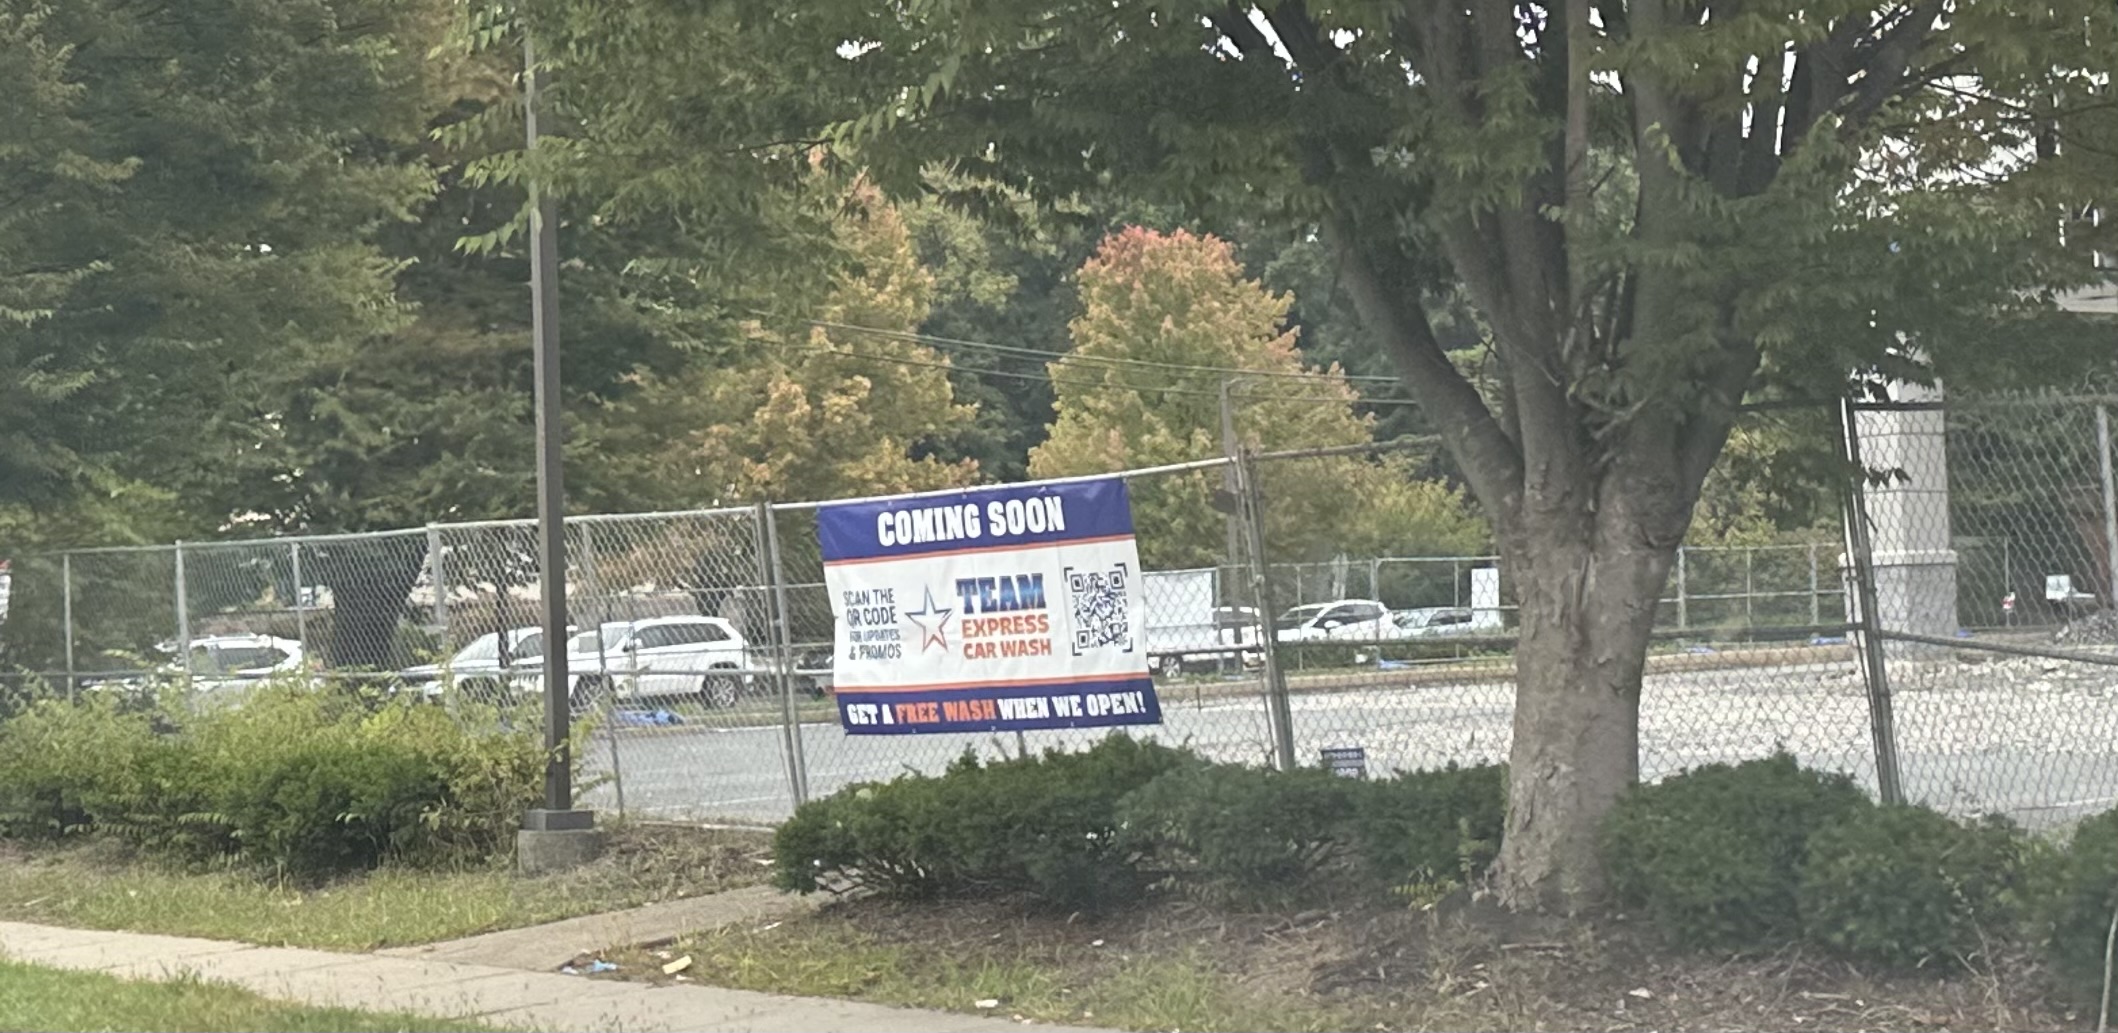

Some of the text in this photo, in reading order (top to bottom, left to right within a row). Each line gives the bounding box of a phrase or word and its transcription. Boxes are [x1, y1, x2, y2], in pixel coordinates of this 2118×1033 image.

[877, 496, 1065, 547] COMING SOON
[843, 588, 895, 607] SCAN THE
[956, 573, 1046, 614] TEAM
[847, 606, 898, 629] QR CODE
[962, 614, 1049, 638] EXPRESS
[863, 629, 901, 642] UPDATES
[859, 644, 902, 660] PROMOS
[963, 639, 1052, 659] CAR WASH
[847, 691, 1146, 725] GET A FREE WASH WHEN WE OPEN!
